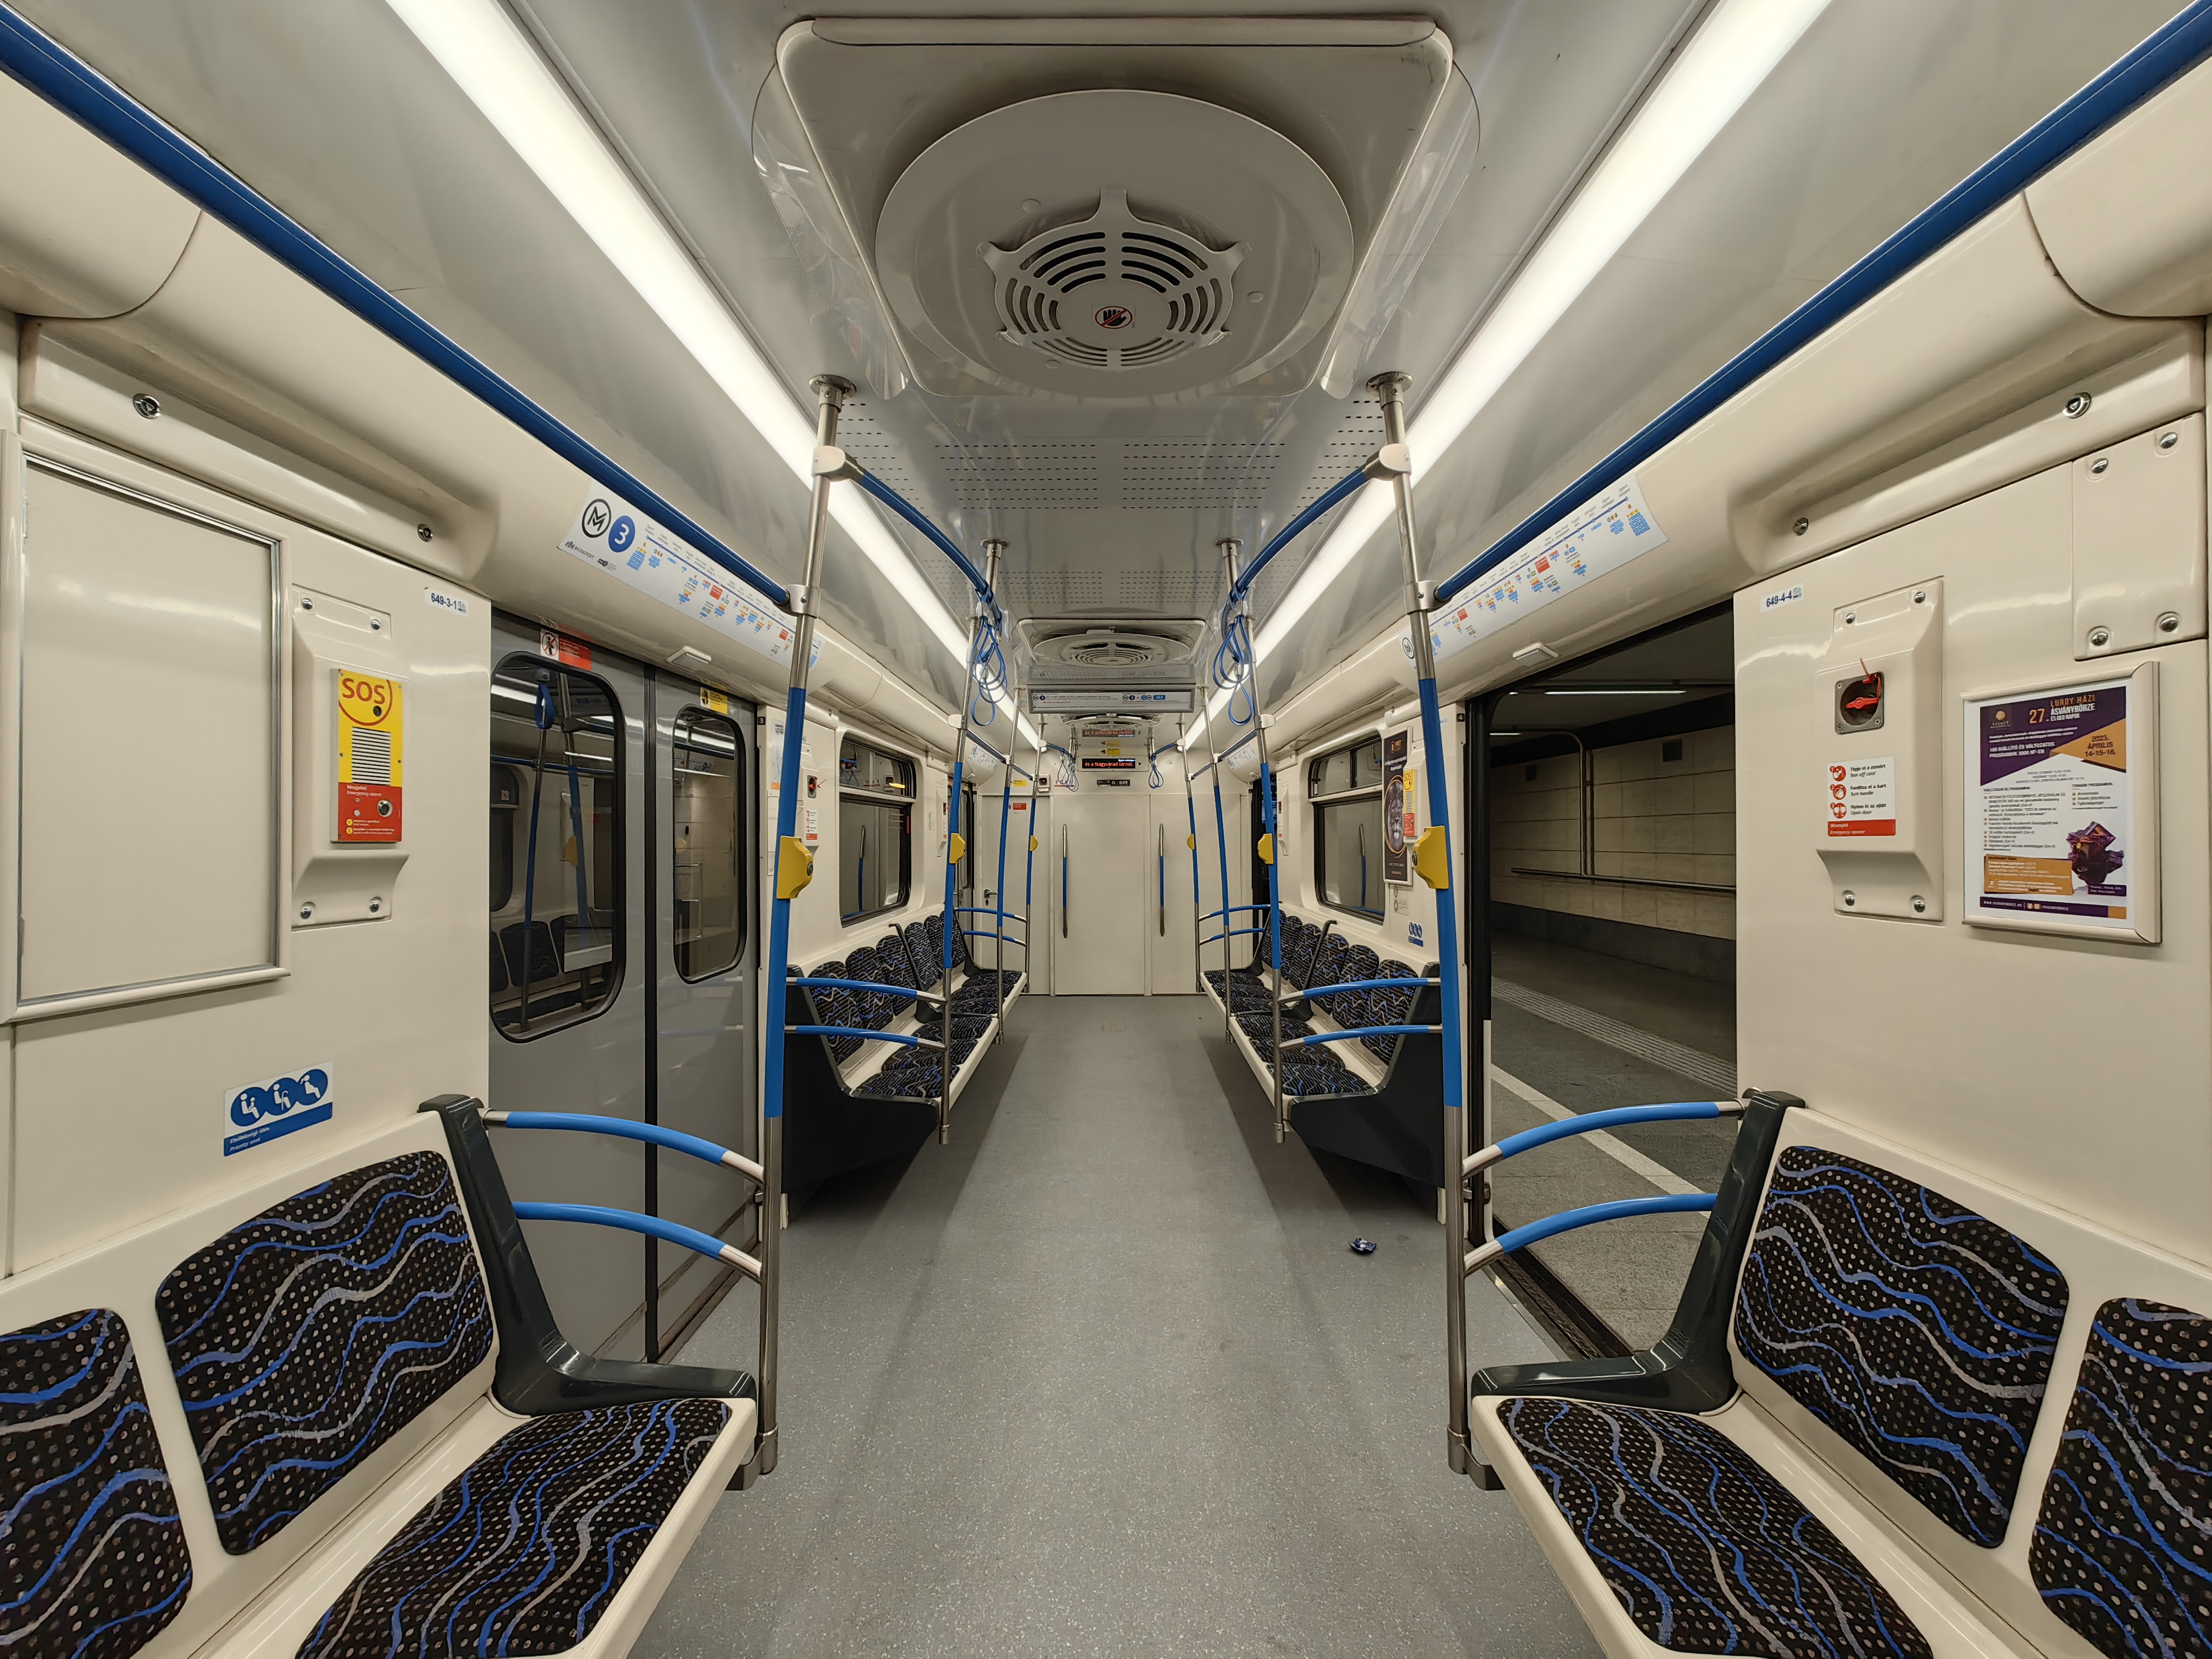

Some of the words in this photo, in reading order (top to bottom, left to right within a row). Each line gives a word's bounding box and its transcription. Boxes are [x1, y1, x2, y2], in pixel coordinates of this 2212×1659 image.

[614, 523, 630, 544] 3
[1766, 590, 1792, 607] 649-4-4
[342, 678, 386, 705] SOS
[2050, 697, 2074, 708] LURDY
[2077, 694, 2096, 703] HÁZI
[2030, 708, 2050, 724] 27.
